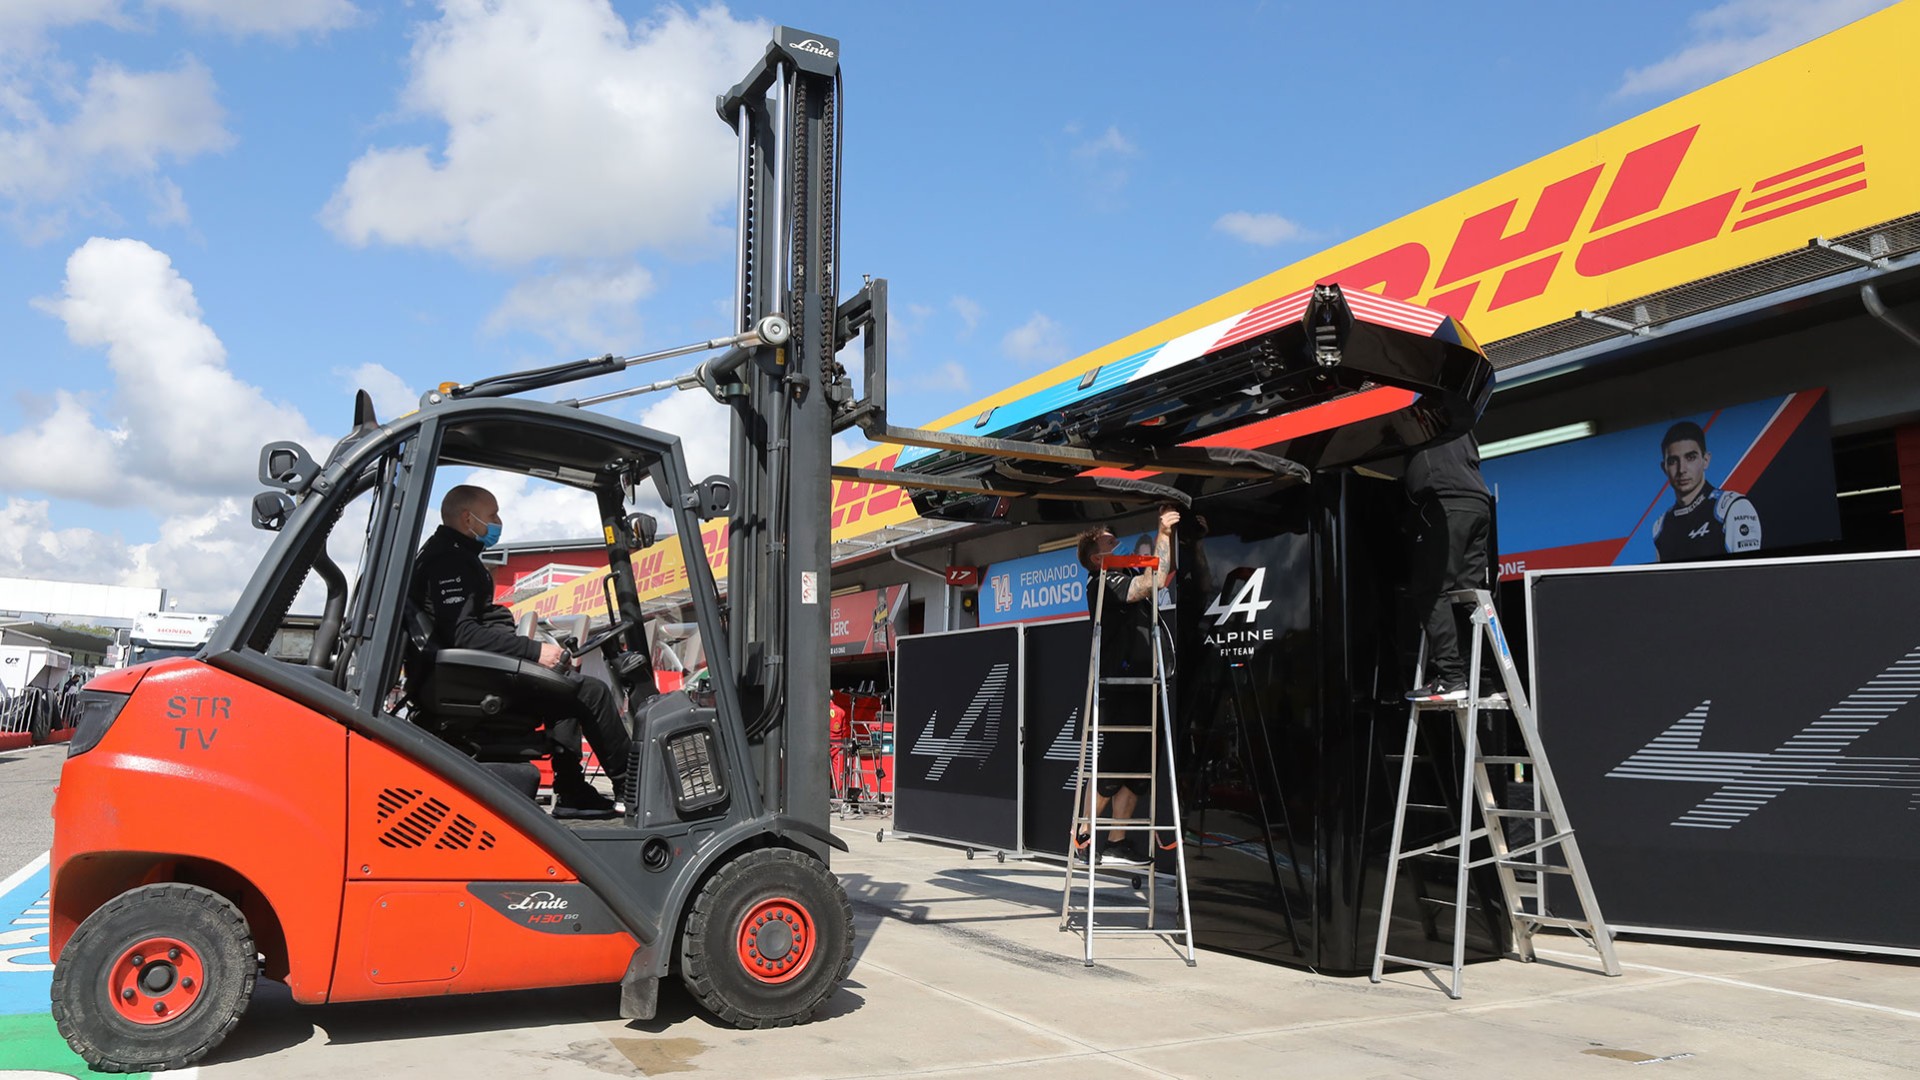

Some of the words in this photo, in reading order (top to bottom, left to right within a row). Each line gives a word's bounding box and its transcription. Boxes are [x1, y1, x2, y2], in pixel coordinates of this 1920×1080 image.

[789, 39, 834, 58] Linde
[950, 570, 972, 580] 17
[1020, 563, 1078, 587] FERNANDO
[991, 574, 1013, 613] 14
[1021, 581, 1083, 609] ALONSO
[157, 627, 193, 635] HONDA
[831, 620, 849, 637] LERC
[1203, 628, 1274, 645] ALPINE
[1233, 646, 1255, 656] TEAM
[166, 695, 232, 719] STR
[175, 727, 218, 750] TV
[507, 890, 569, 910] Linde
